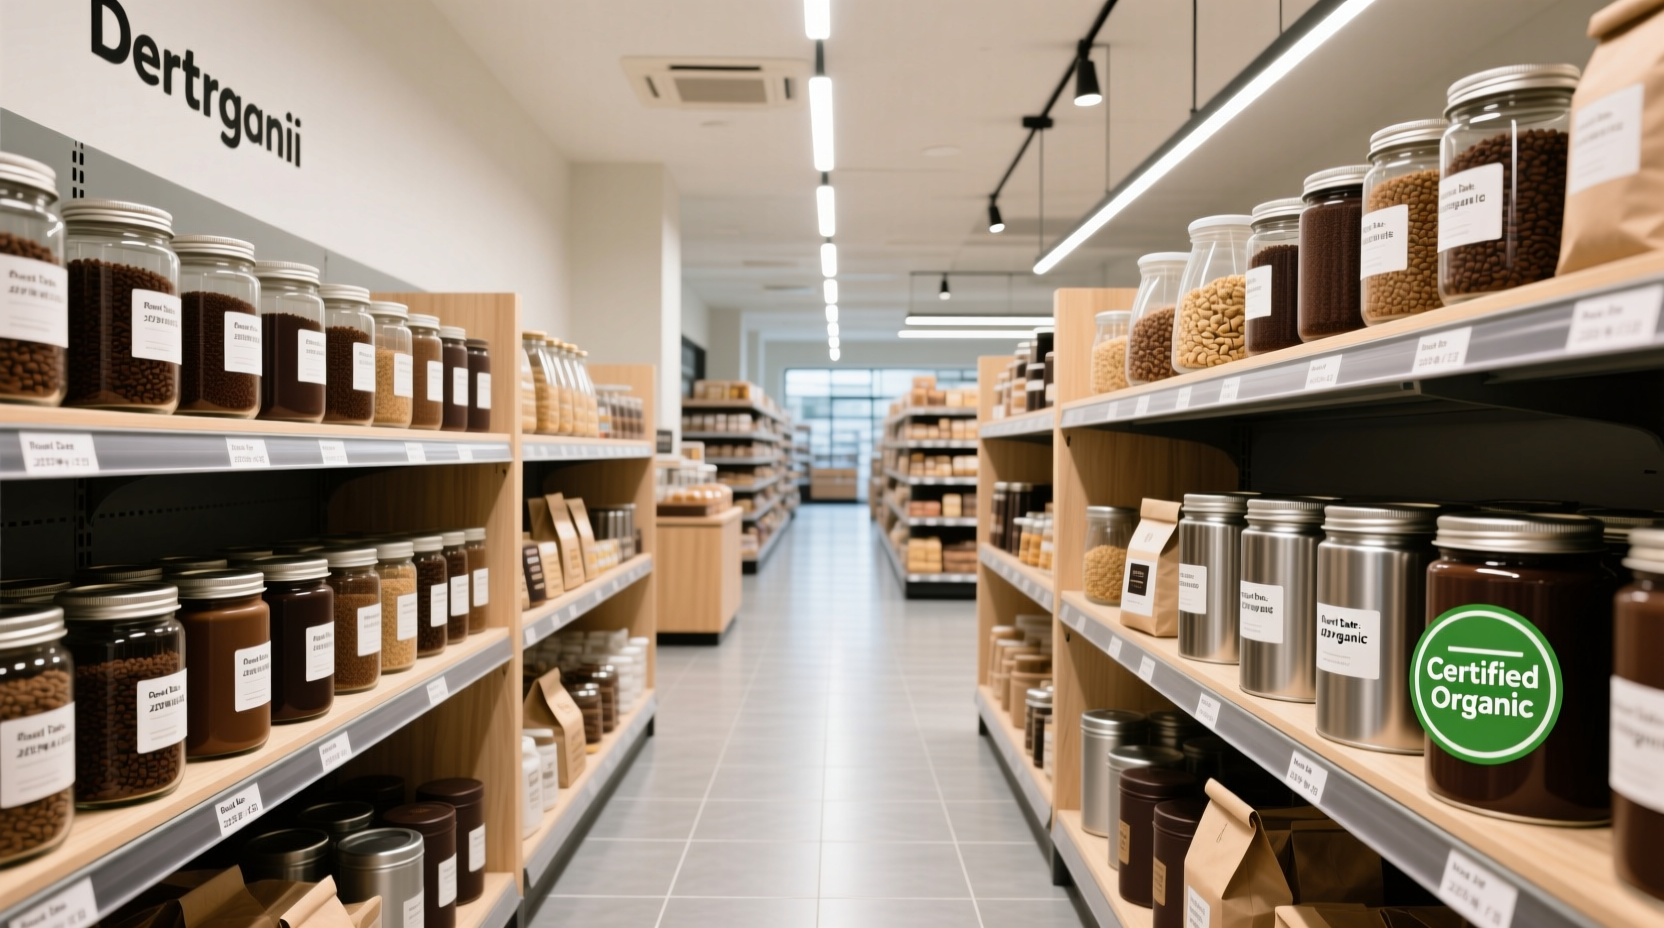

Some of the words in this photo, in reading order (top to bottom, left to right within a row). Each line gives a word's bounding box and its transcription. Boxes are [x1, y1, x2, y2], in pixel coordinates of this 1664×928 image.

[91, 0, 301, 168] Dertrganii
[1427, 656, 1538, 689] Certified
[1431, 685, 1534, 719] Organic
